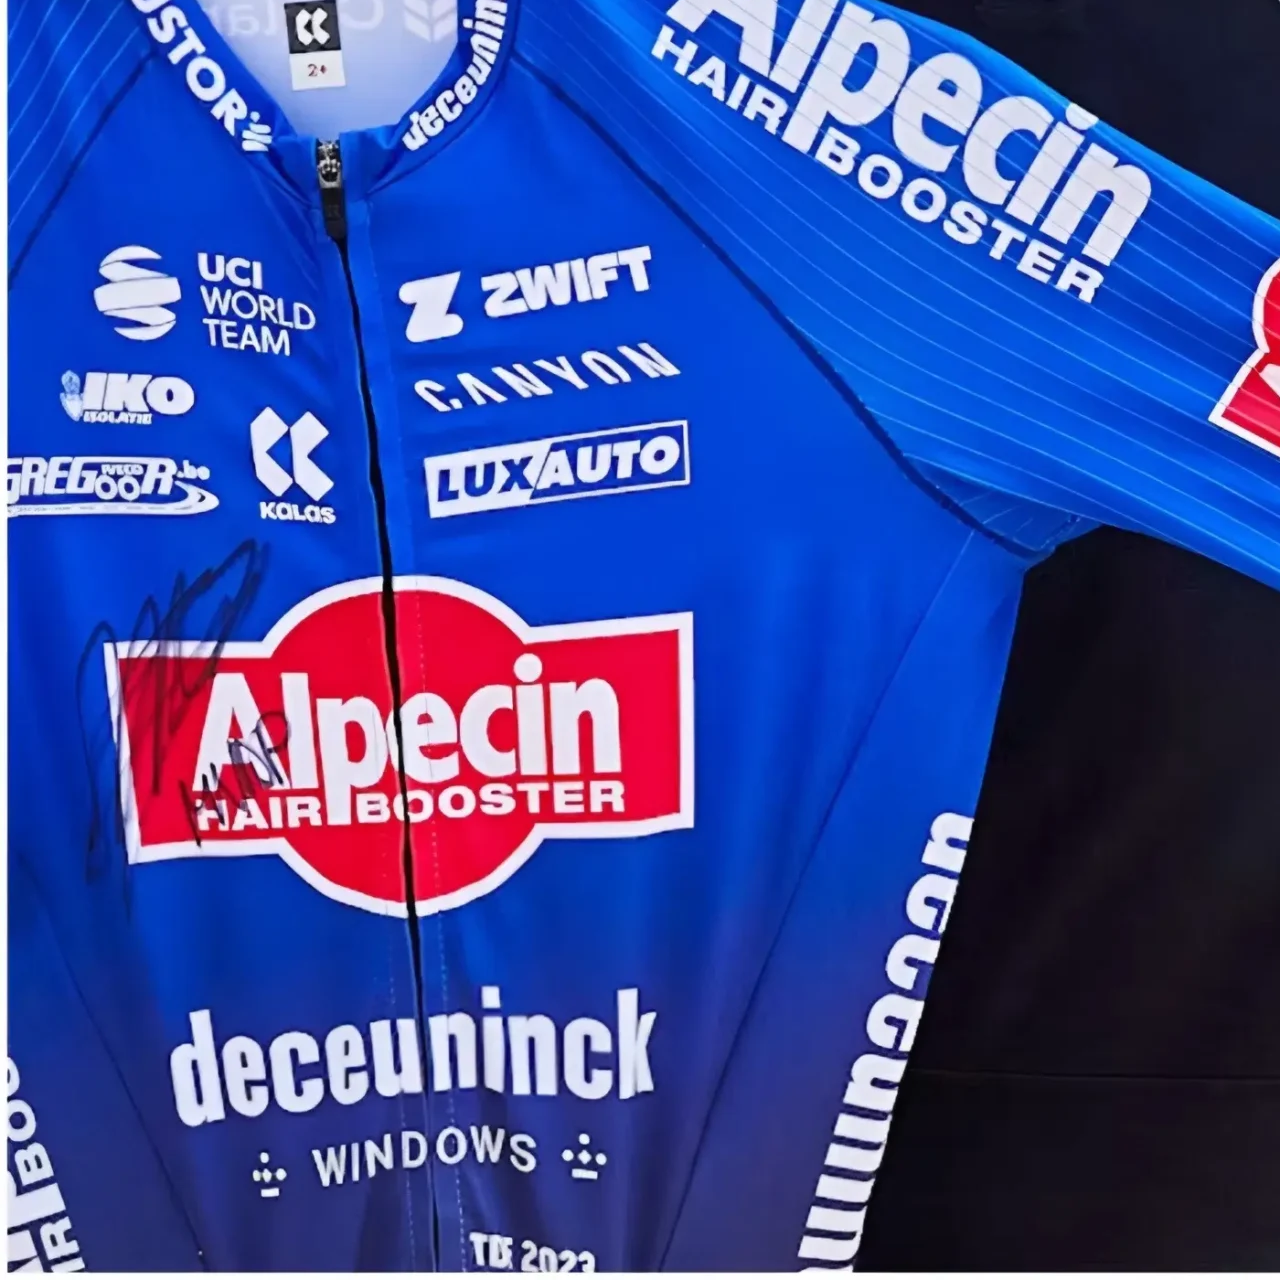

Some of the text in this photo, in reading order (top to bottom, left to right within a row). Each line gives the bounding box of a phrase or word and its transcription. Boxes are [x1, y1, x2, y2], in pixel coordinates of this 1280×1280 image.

[651, 25, 1104, 303] HAIR BOOSTER
[198, 252, 262, 286] UCI
[481, 246, 651, 318] ZWIFT
[200, 285, 316, 331] WORLD
[202, 319, 291, 356] TEAM
[83, 372, 195, 415] IKO
[414, 342, 681, 412] CANYON
[192, 653, 622, 825] Alpecin
[195, 779, 625, 832] HAIR BOOSTER
[170, 985, 657, 1127] deceuninck
[312, 1125, 538, 1188] WINDOWS
[521, 1240, 596, 1273] 2023
